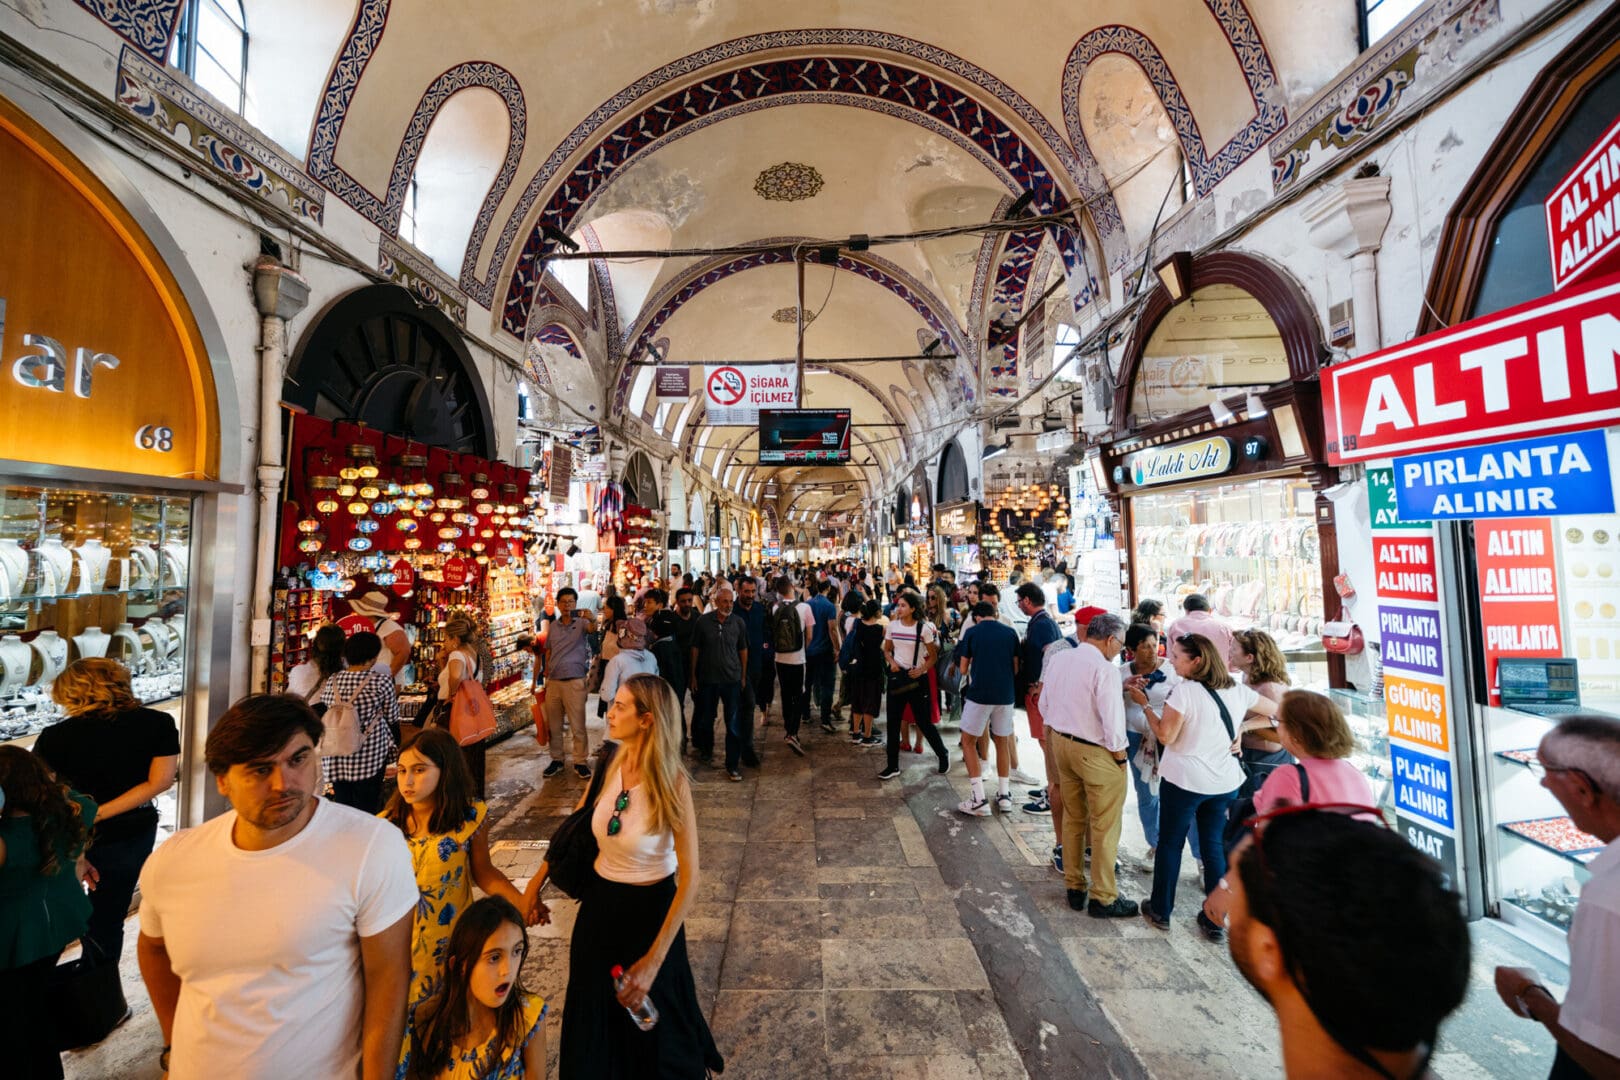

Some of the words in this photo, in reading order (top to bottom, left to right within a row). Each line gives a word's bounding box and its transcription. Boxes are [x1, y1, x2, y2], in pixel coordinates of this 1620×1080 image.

[750, 375, 789, 388] SİGARA
[750, 390, 794, 405] İÇİLMEZ
[134, 424, 173, 453] 68
[1245, 441, 1258, 455] 97
[1343, 435, 1357, 452] 99
[1403, 443, 1592, 488] PIRLANTA
[1371, 472, 1389, 487] 14
[1432, 487, 1557, 515] ALINIR
[1379, 544, 1428, 565] ALTIN
[1487, 529, 1545, 556] ALTIN
[447, 564, 463, 572] Fixed
[447, 573, 463, 581] Price
[1485, 567, 1553, 594] ALINIR
[1378, 571, 1434, 594] ALINIR
[352, 623, 362, 634] 10
[1381, 612, 1438, 639] PIRLANTA
[1486, 624, 1559, 651] PIRLANTA
[1386, 640, 1438, 668] ALINIR
[1388, 682, 1442, 719] GÜMÜŞ
[1393, 714, 1443, 745] ALINIR
[1395, 756, 1447, 792] PLATİN
[1400, 784, 1448, 820] ALINIR
[1407, 826, 1443, 860] SAAT
